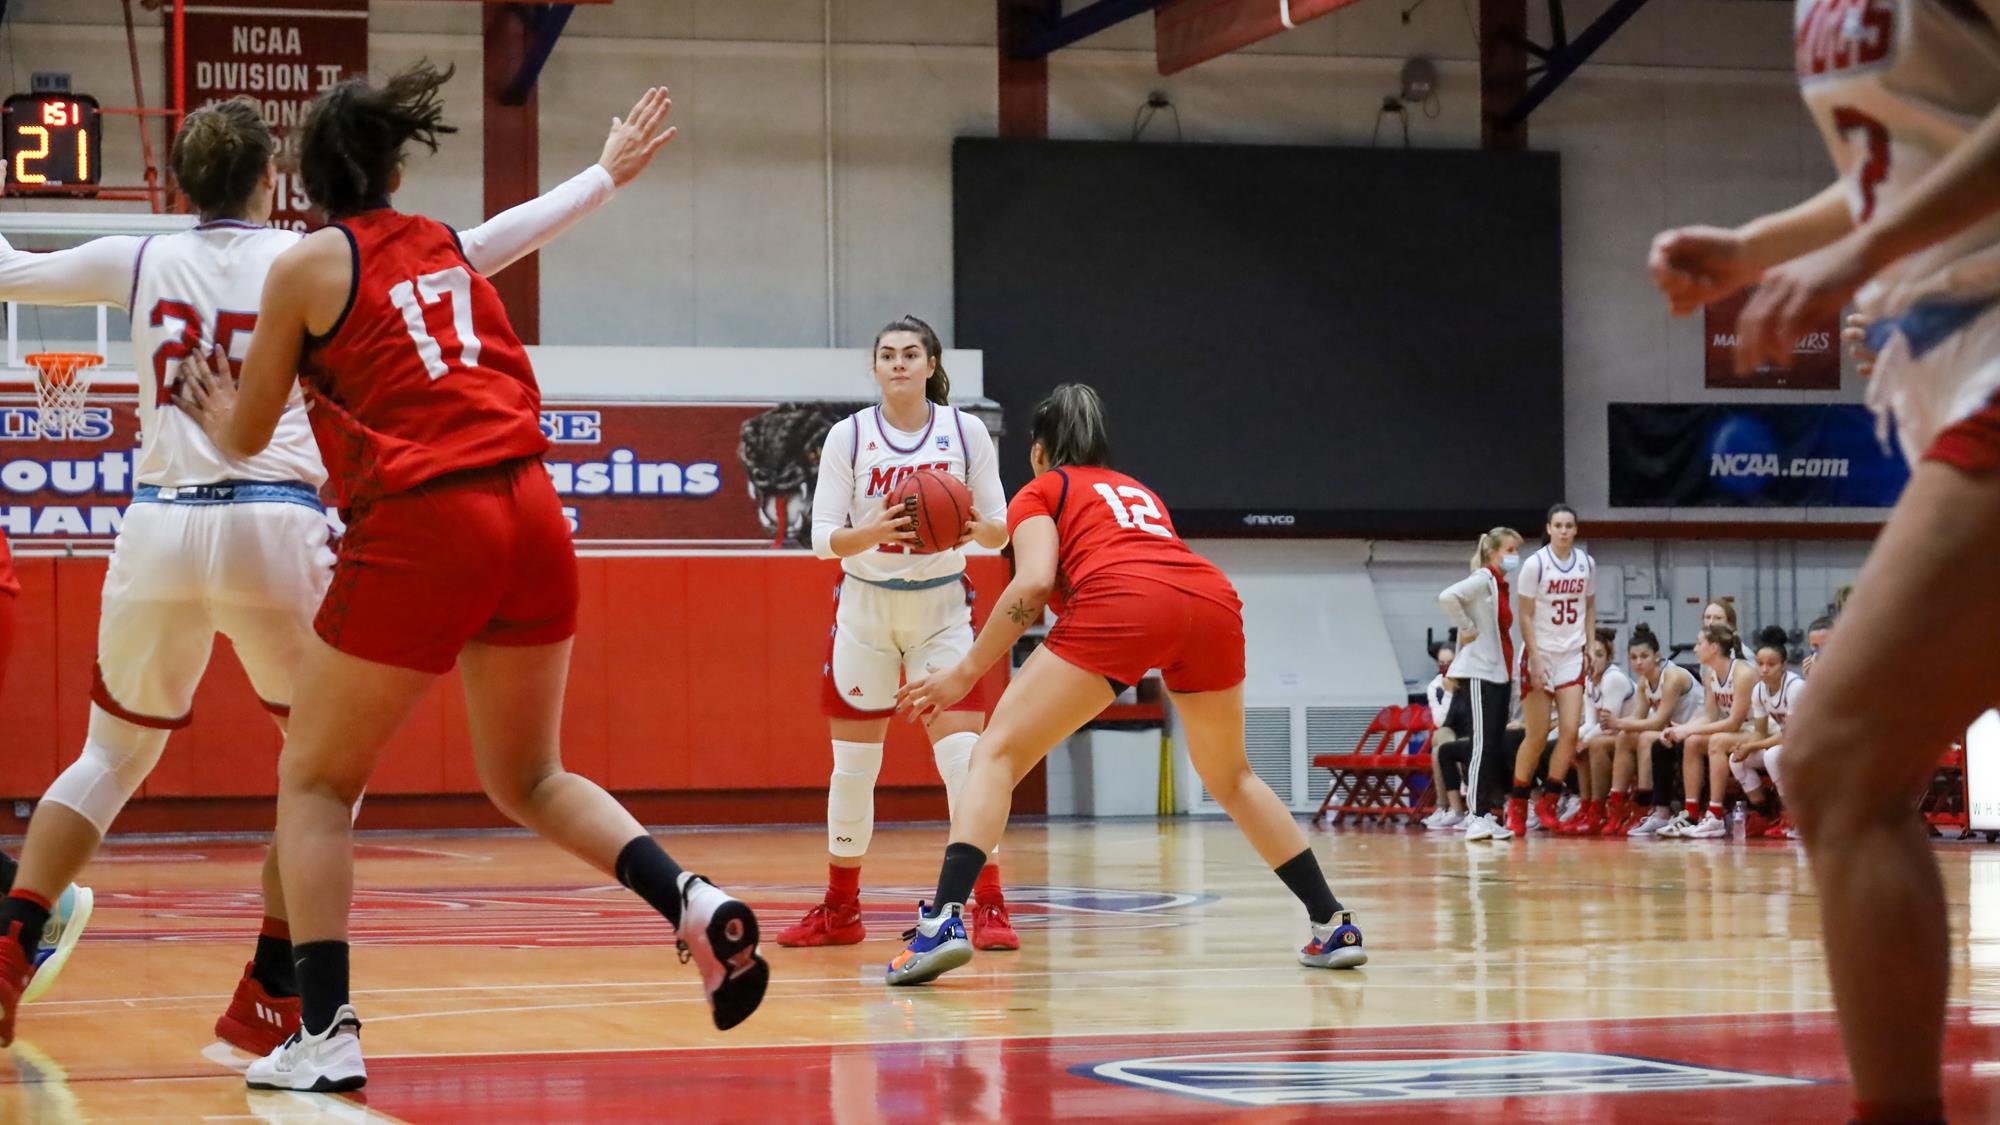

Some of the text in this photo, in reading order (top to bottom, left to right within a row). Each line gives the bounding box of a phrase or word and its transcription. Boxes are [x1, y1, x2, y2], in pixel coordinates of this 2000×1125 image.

[232, 26, 302, 55] NCAA
[196, 61, 309, 91] DIVISION
[16, 125, 88, 183] 21
[389, 265, 482, 381] 17
[1710, 453, 1849, 477] NCAA.com
[1093, 483, 1173, 538] 12
[1547, 578, 1585, 594] MOCS
[1552, 598, 1578, 625] 35
